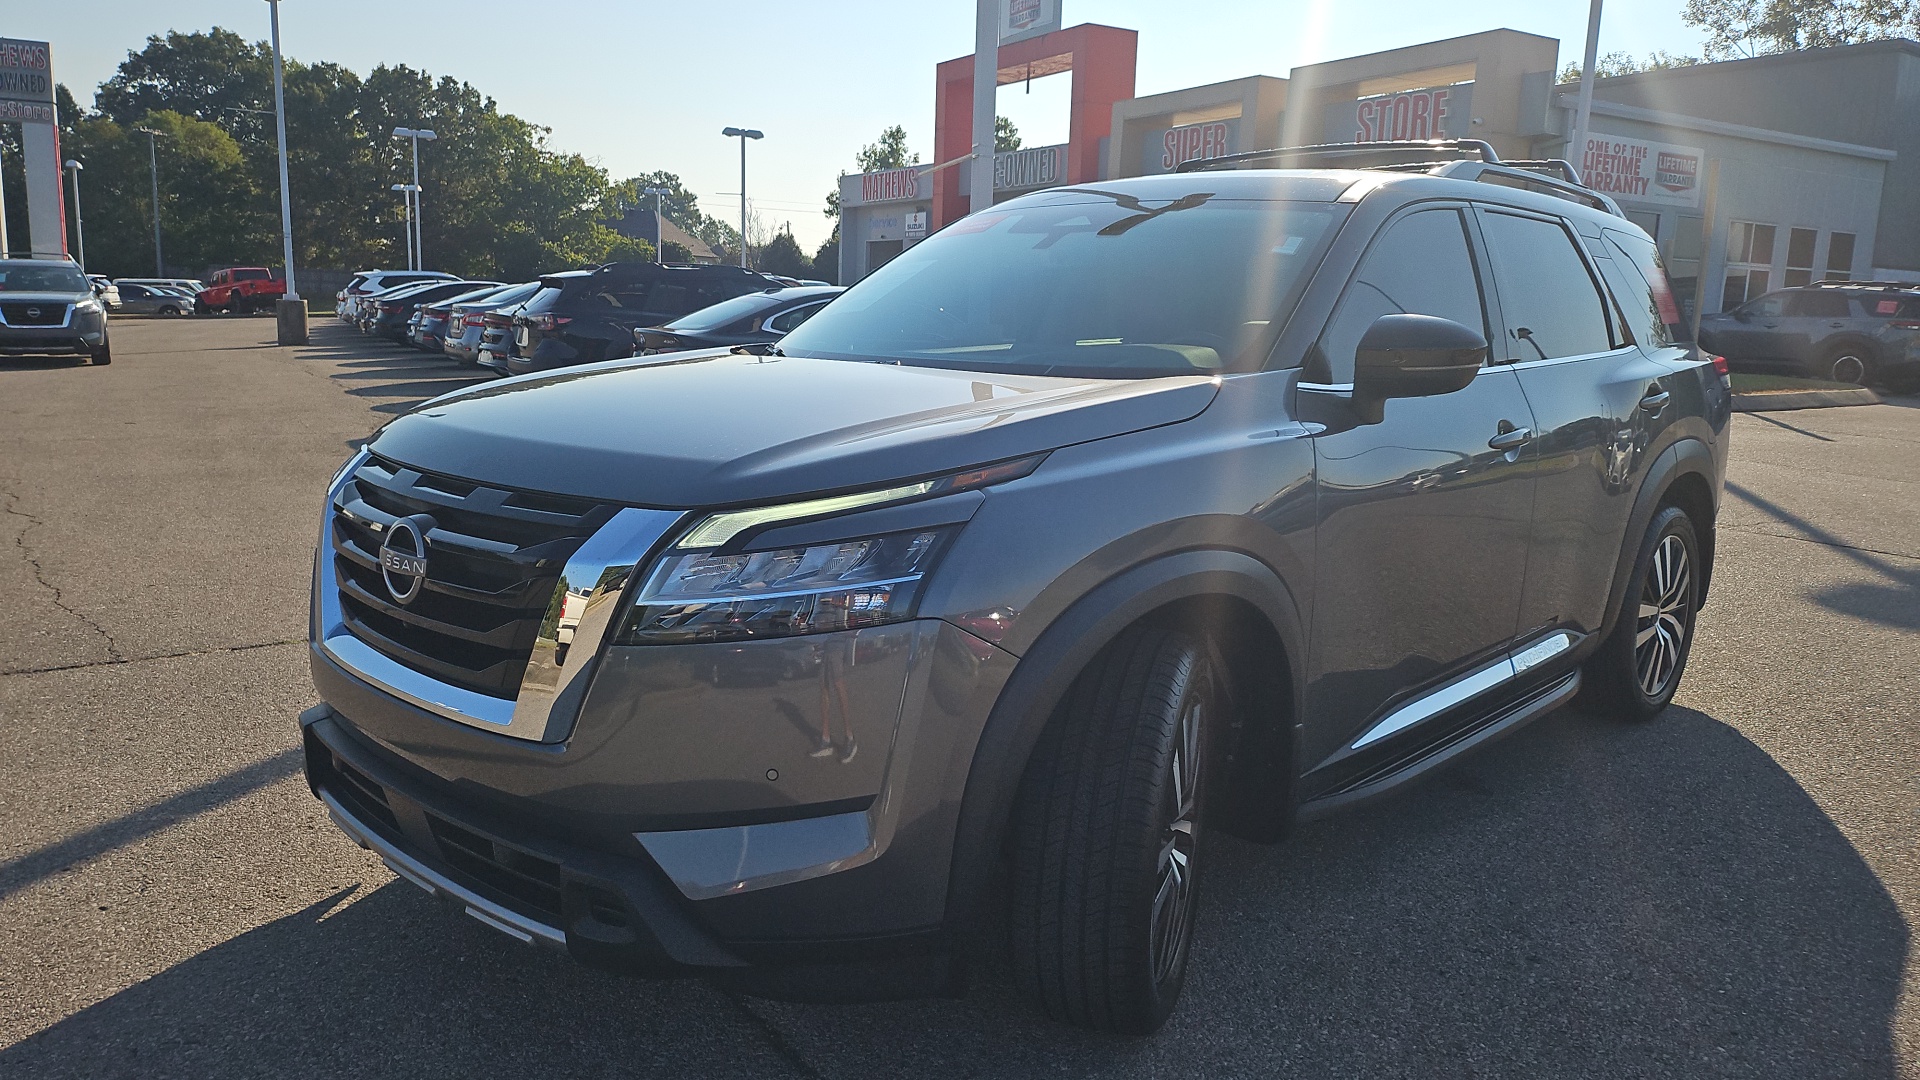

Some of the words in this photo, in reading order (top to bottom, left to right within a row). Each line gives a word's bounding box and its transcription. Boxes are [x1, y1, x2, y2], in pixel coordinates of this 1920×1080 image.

[1355, 89, 1449, 143] STORE
[1162, 123, 1227, 170] SUPER
[1587, 139, 1610, 154] ONE
[1613, 142, 1627, 156] OF
[1630, 144, 1648, 158] THE
[1583, 150, 1642, 176] LIFETIME
[1658, 155, 1696, 173] LIFETIME
[862, 168, 916, 203] MATHEWS
[385, 553, 424, 574] SSAN
